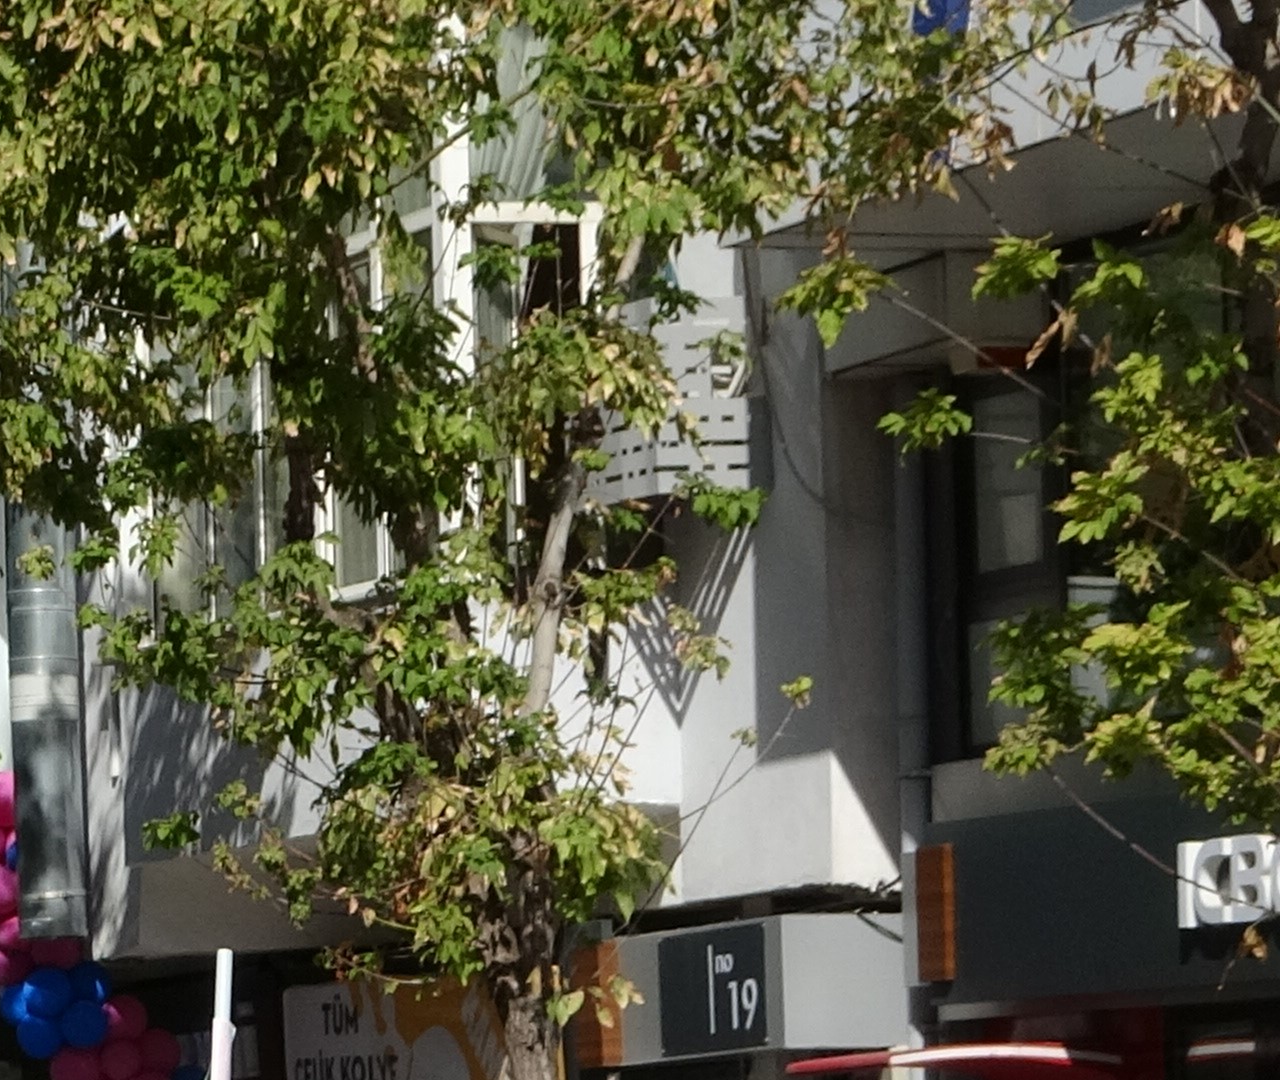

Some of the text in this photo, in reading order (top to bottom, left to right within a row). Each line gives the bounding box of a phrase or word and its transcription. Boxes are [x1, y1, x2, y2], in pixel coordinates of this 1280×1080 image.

[715, 953, 734, 974] no
[321, 993, 359, 1036] TÜM
[727, 977, 758, 1030] 19
